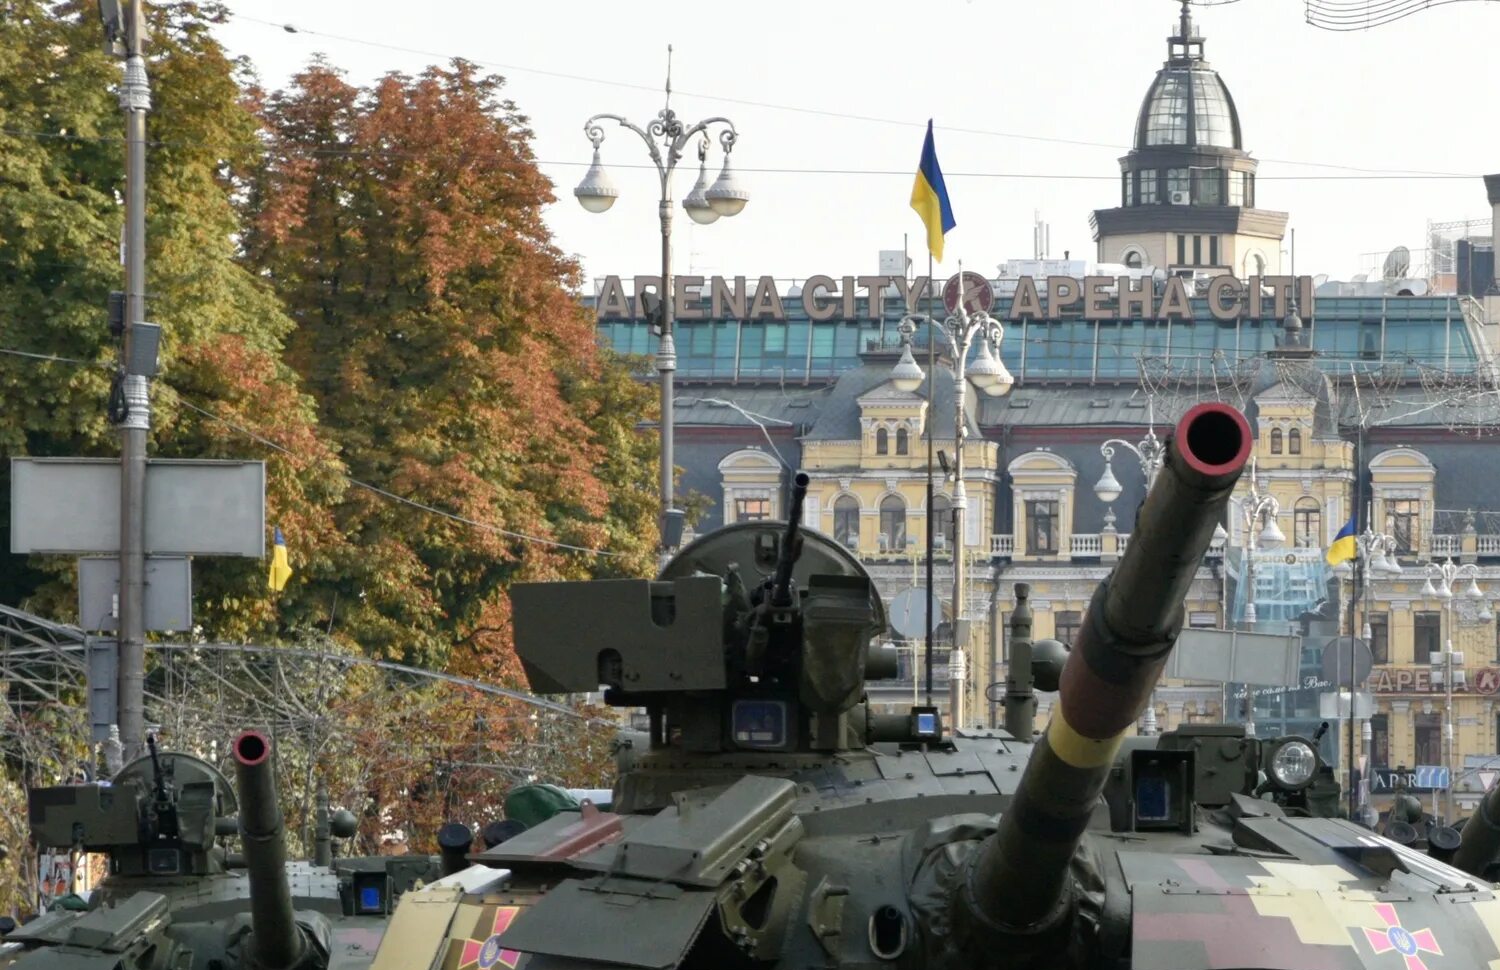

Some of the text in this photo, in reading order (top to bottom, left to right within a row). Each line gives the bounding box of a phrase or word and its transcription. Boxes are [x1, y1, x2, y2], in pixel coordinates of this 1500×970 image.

[801, 275, 930, 320] CITY
[1009, 275, 1315, 321] АРЕНА СІТІ
